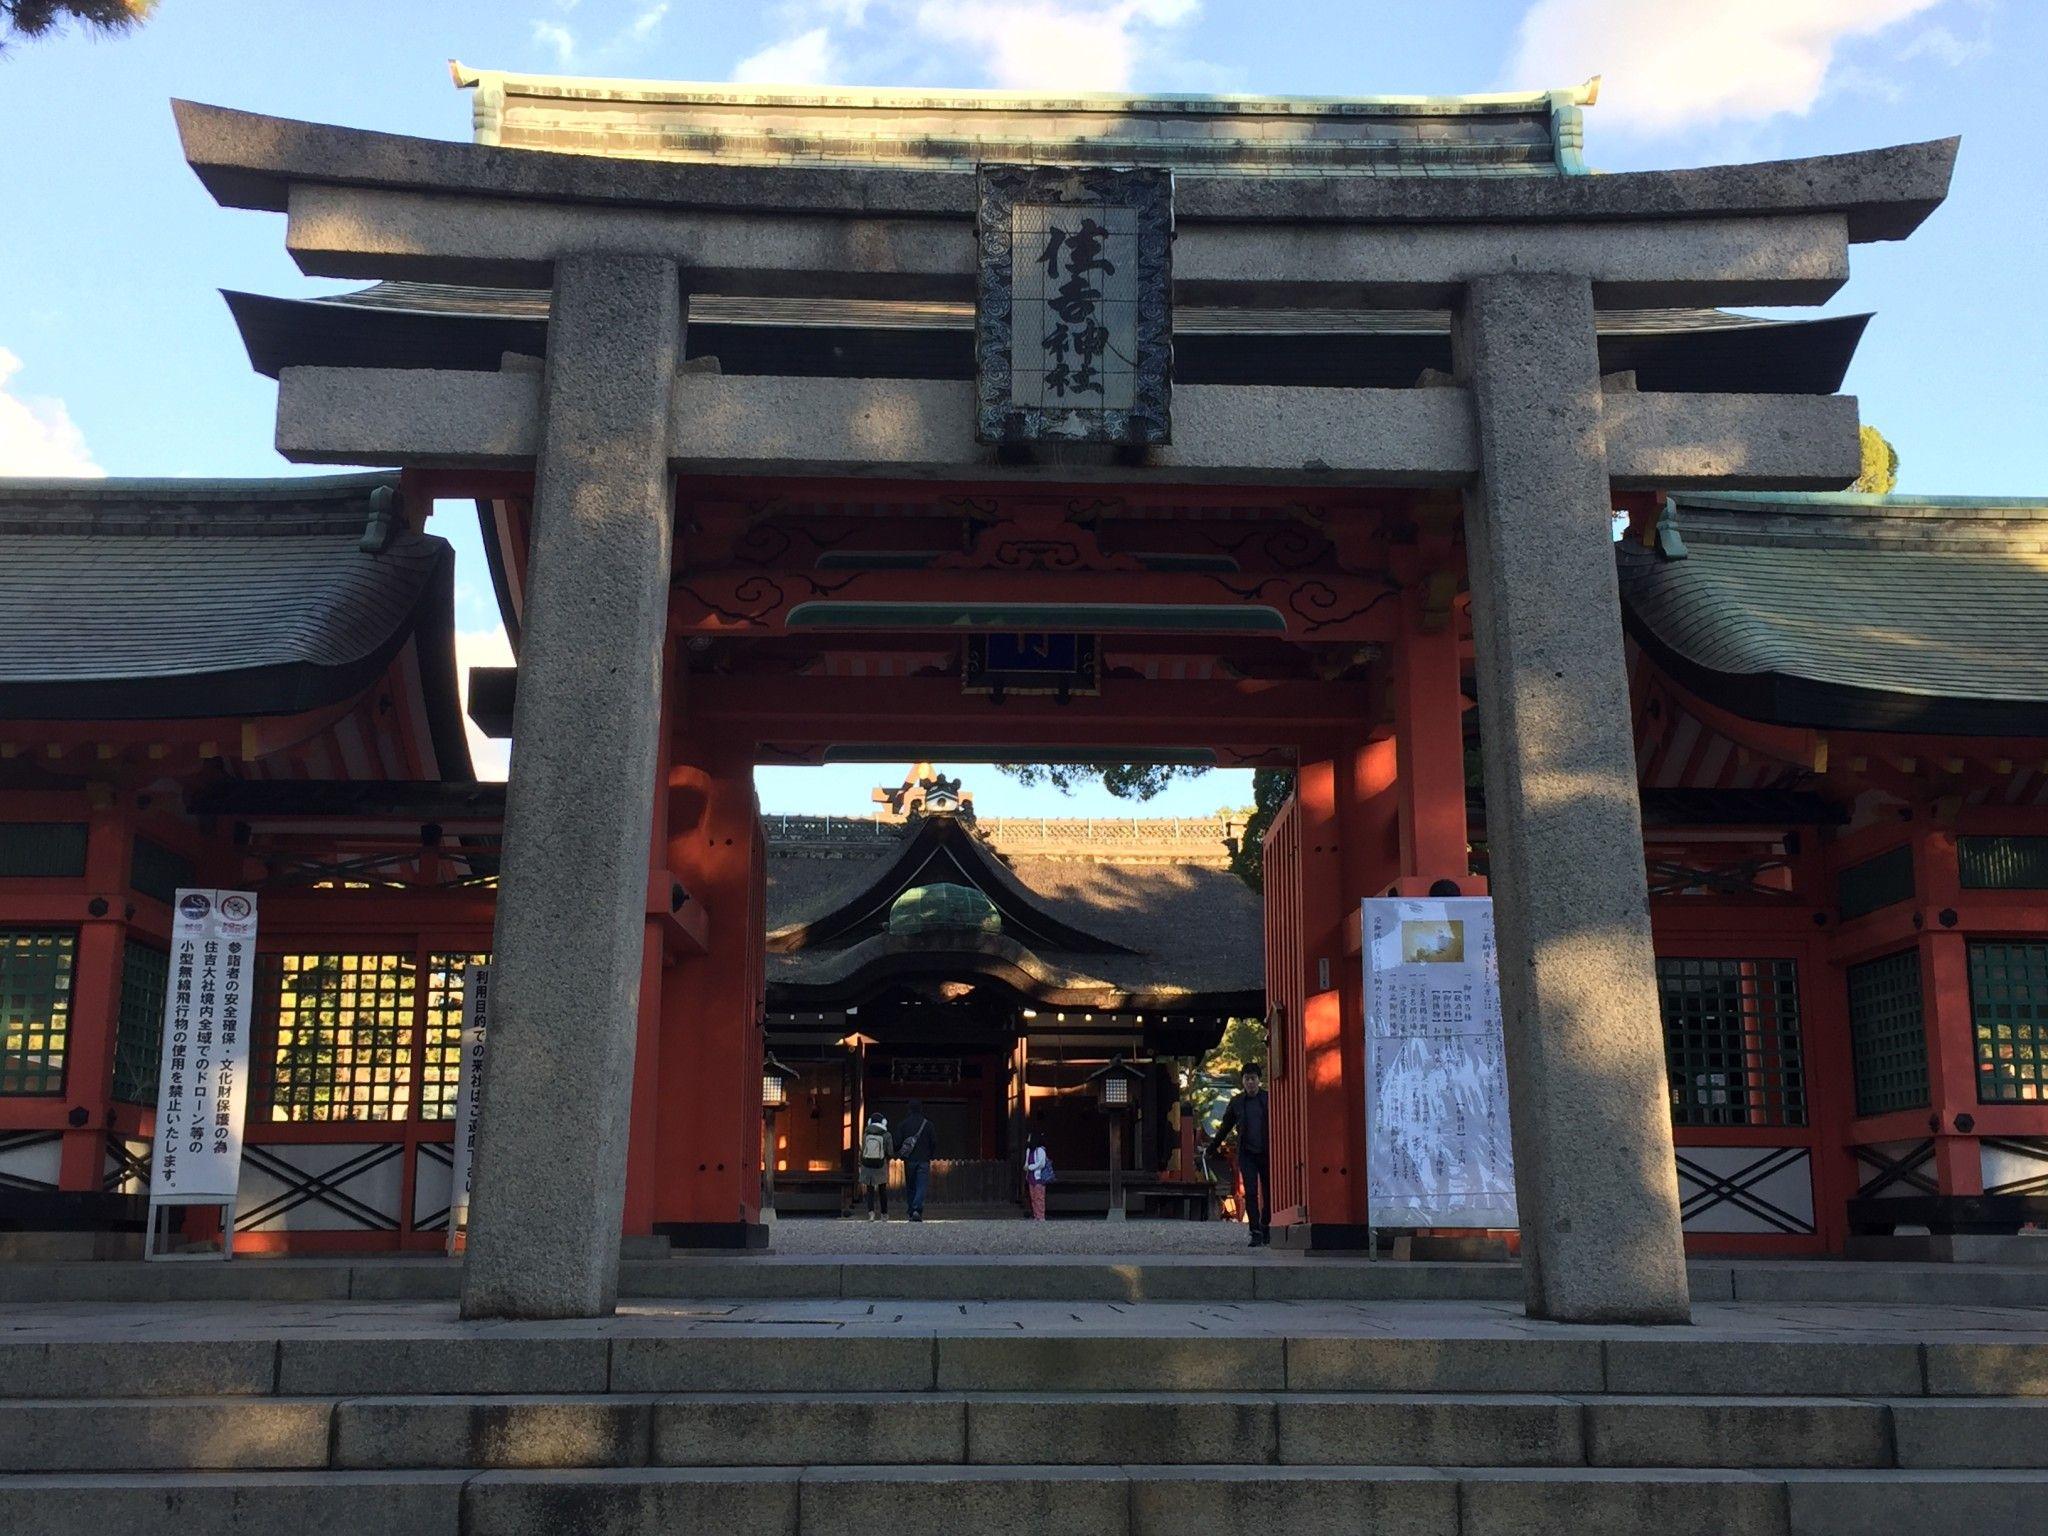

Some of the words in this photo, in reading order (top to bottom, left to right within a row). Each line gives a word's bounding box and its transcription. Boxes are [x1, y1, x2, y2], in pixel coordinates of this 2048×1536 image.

[162, 940, 195, 1188] 小型無線飛行物の使用を禁止いたします。
[189, 941, 218, 1154] 住吉大社境内全域でのドローン等の
[213, 941, 242, 1155] 参詣者の安全確保・文化財保護の為
